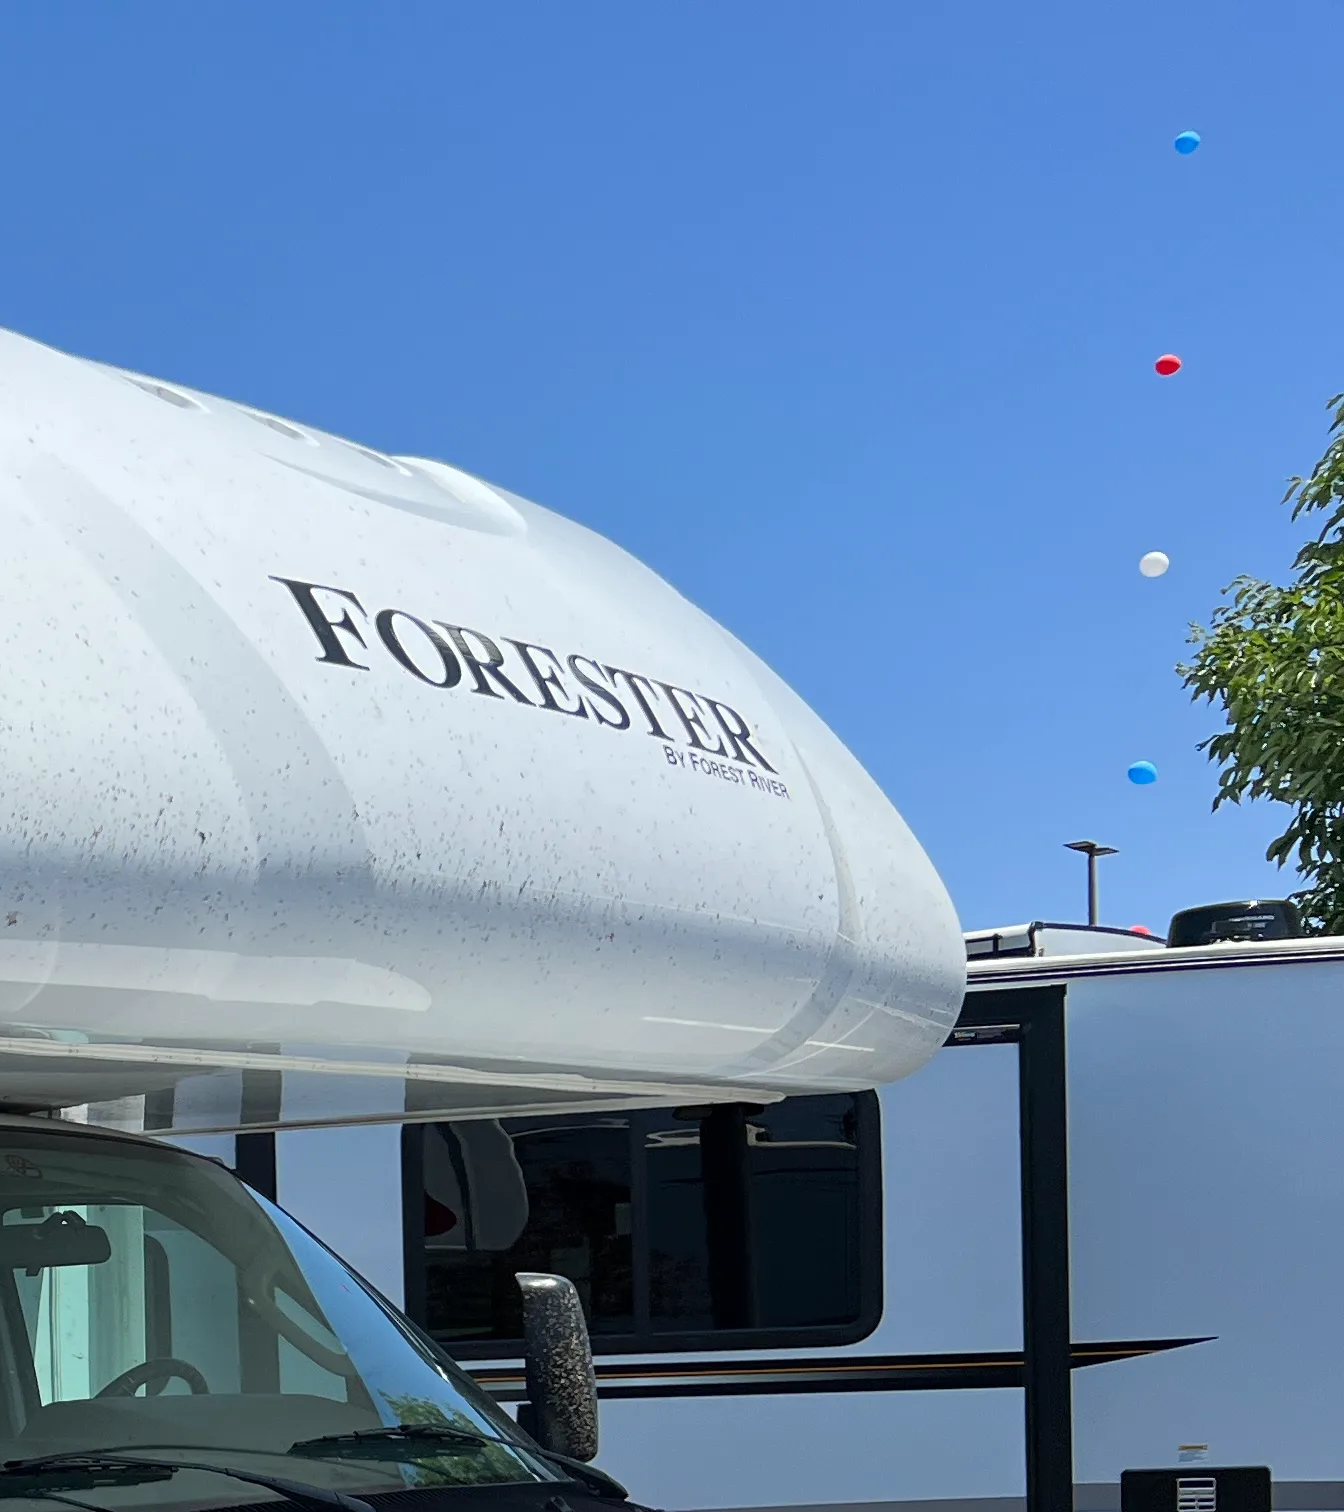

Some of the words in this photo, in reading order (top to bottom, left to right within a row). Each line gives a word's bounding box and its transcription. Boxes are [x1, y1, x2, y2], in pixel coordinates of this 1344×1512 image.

[267, 575, 779, 775] FORESTER
[662, 744, 686, 769] BY
[688, 751, 746, 786] FOREST
[746, 769, 792, 800] RIVER
